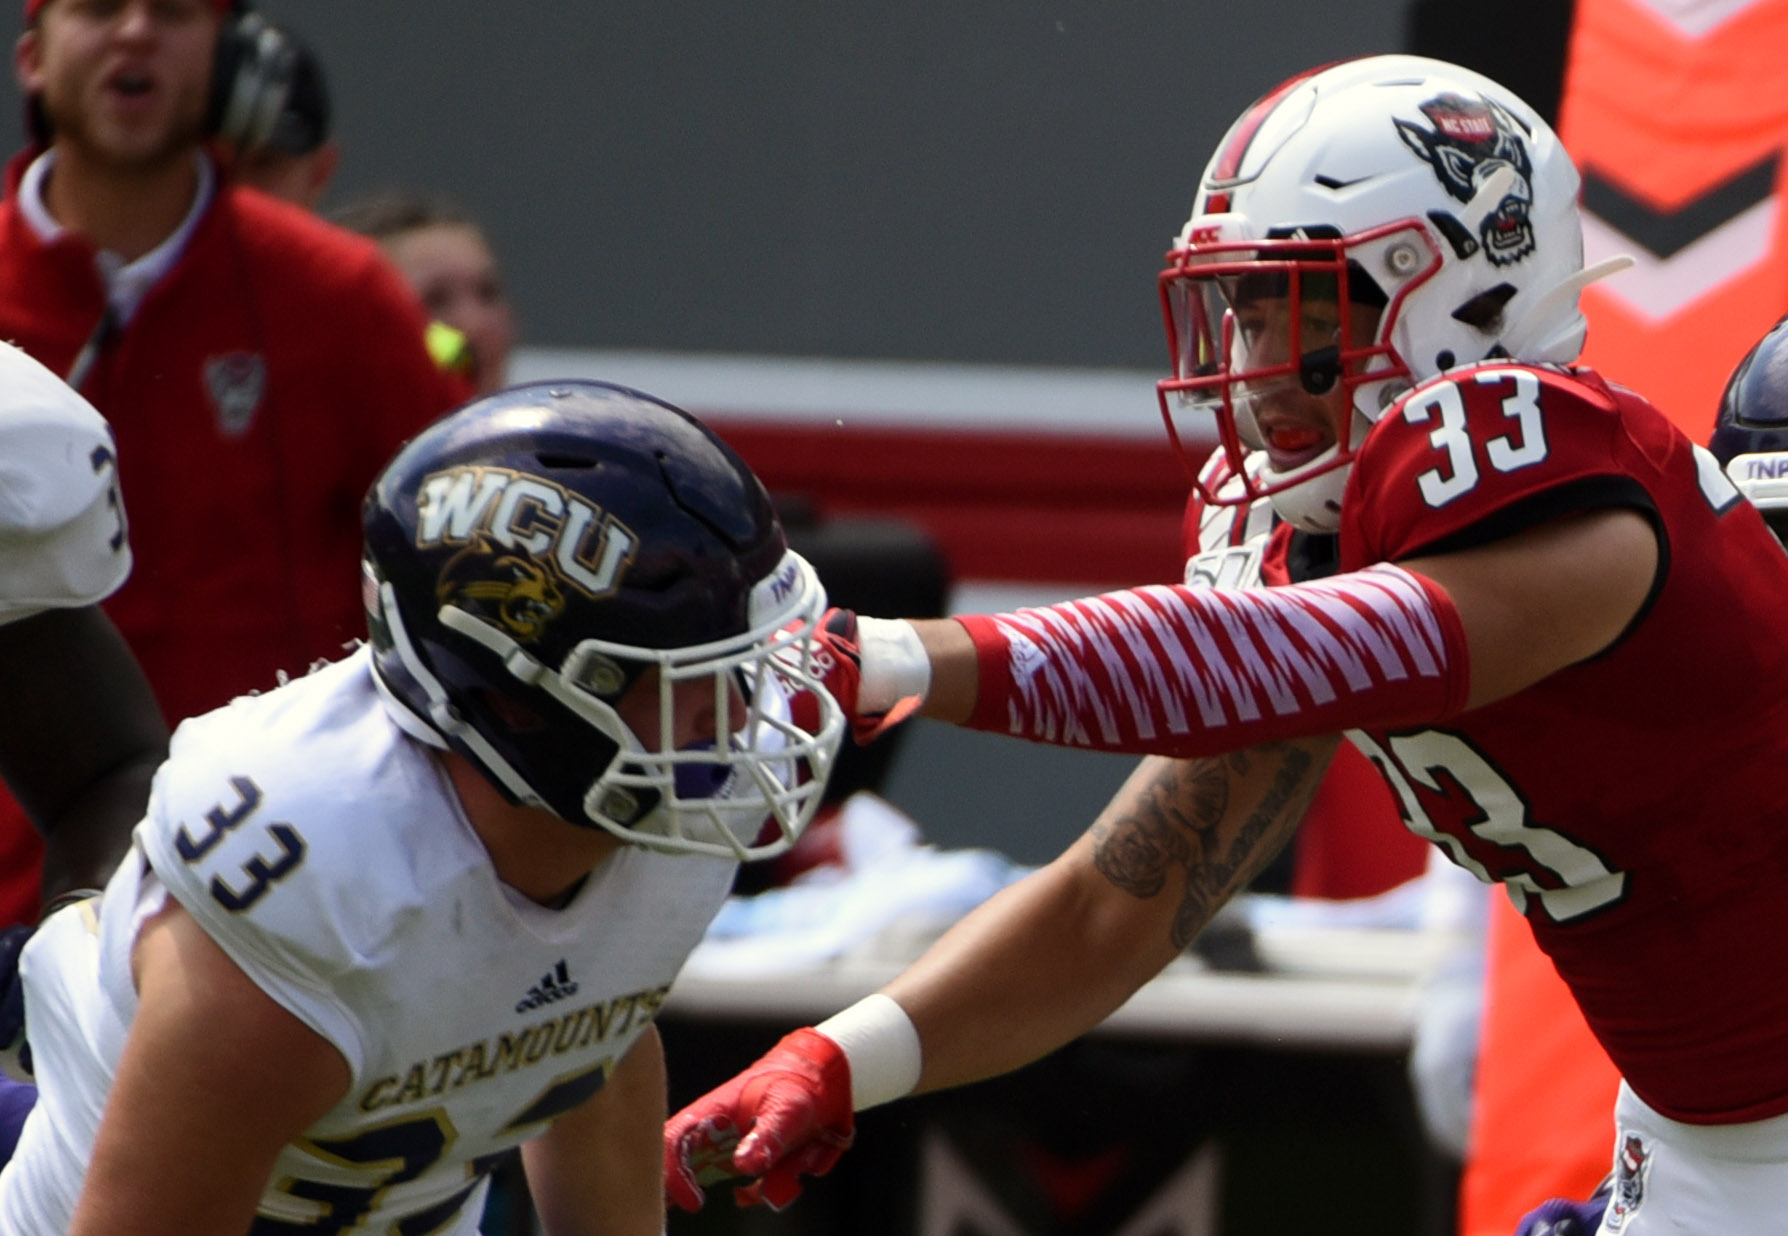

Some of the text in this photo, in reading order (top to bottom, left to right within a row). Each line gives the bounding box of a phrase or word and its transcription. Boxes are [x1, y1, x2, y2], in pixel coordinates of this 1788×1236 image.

[1402, 371, 1551, 508] 33
[417, 465, 639, 598] WCU
[172, 775, 309, 914] 33
